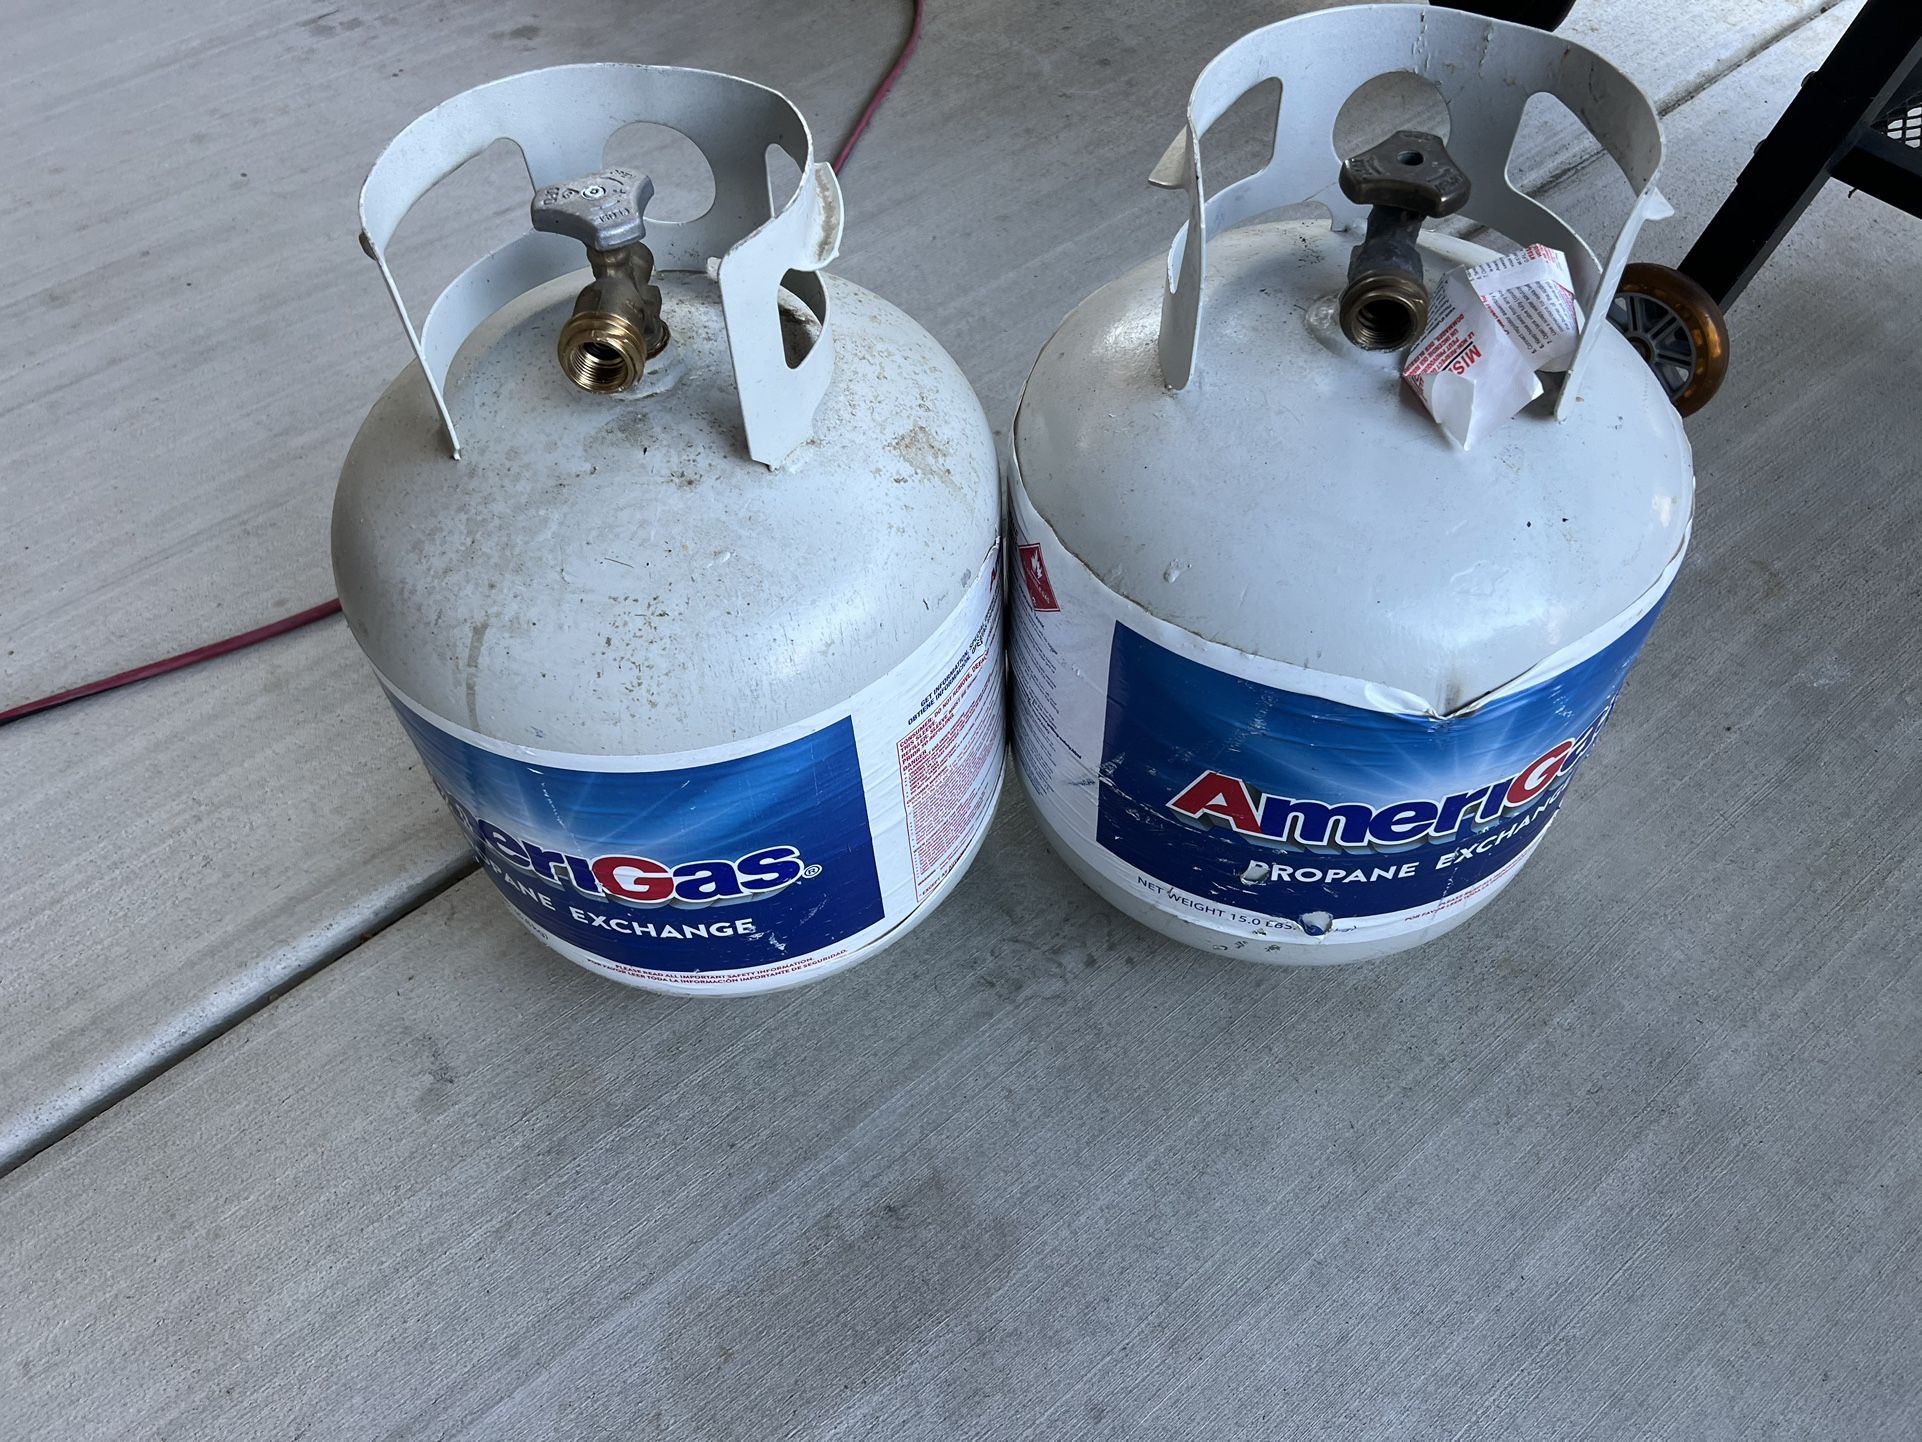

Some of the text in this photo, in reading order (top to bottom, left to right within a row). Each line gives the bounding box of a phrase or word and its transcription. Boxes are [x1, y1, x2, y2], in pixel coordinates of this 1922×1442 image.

[920, 691, 933, 707] GET
[934, 707, 942, 718] DO
[942, 695, 953, 709] NOT
[908, 697, 935, 726] OBTIENE
[901, 739, 914, 753] THIS
[902, 747, 920, 765] PRIOR
[902, 749, 926, 772] DANGER
[1137, 876, 1162, 895] NET
[1168, 892, 1226, 918] WEIGHT
[1231, 913, 1261, 926] 15.0
[569, 906, 754, 939] EXCHANGE
[615, 964, 641, 974] PLEASE
[728, 970, 756, 979] SAFETY
[627, 971, 646, 979] LEER
[646, 975, 668, 983] TODA
[740, 968, 790, 981] IMPORTANTE
[802, 949, 848, 970] SEGURIDAD.
